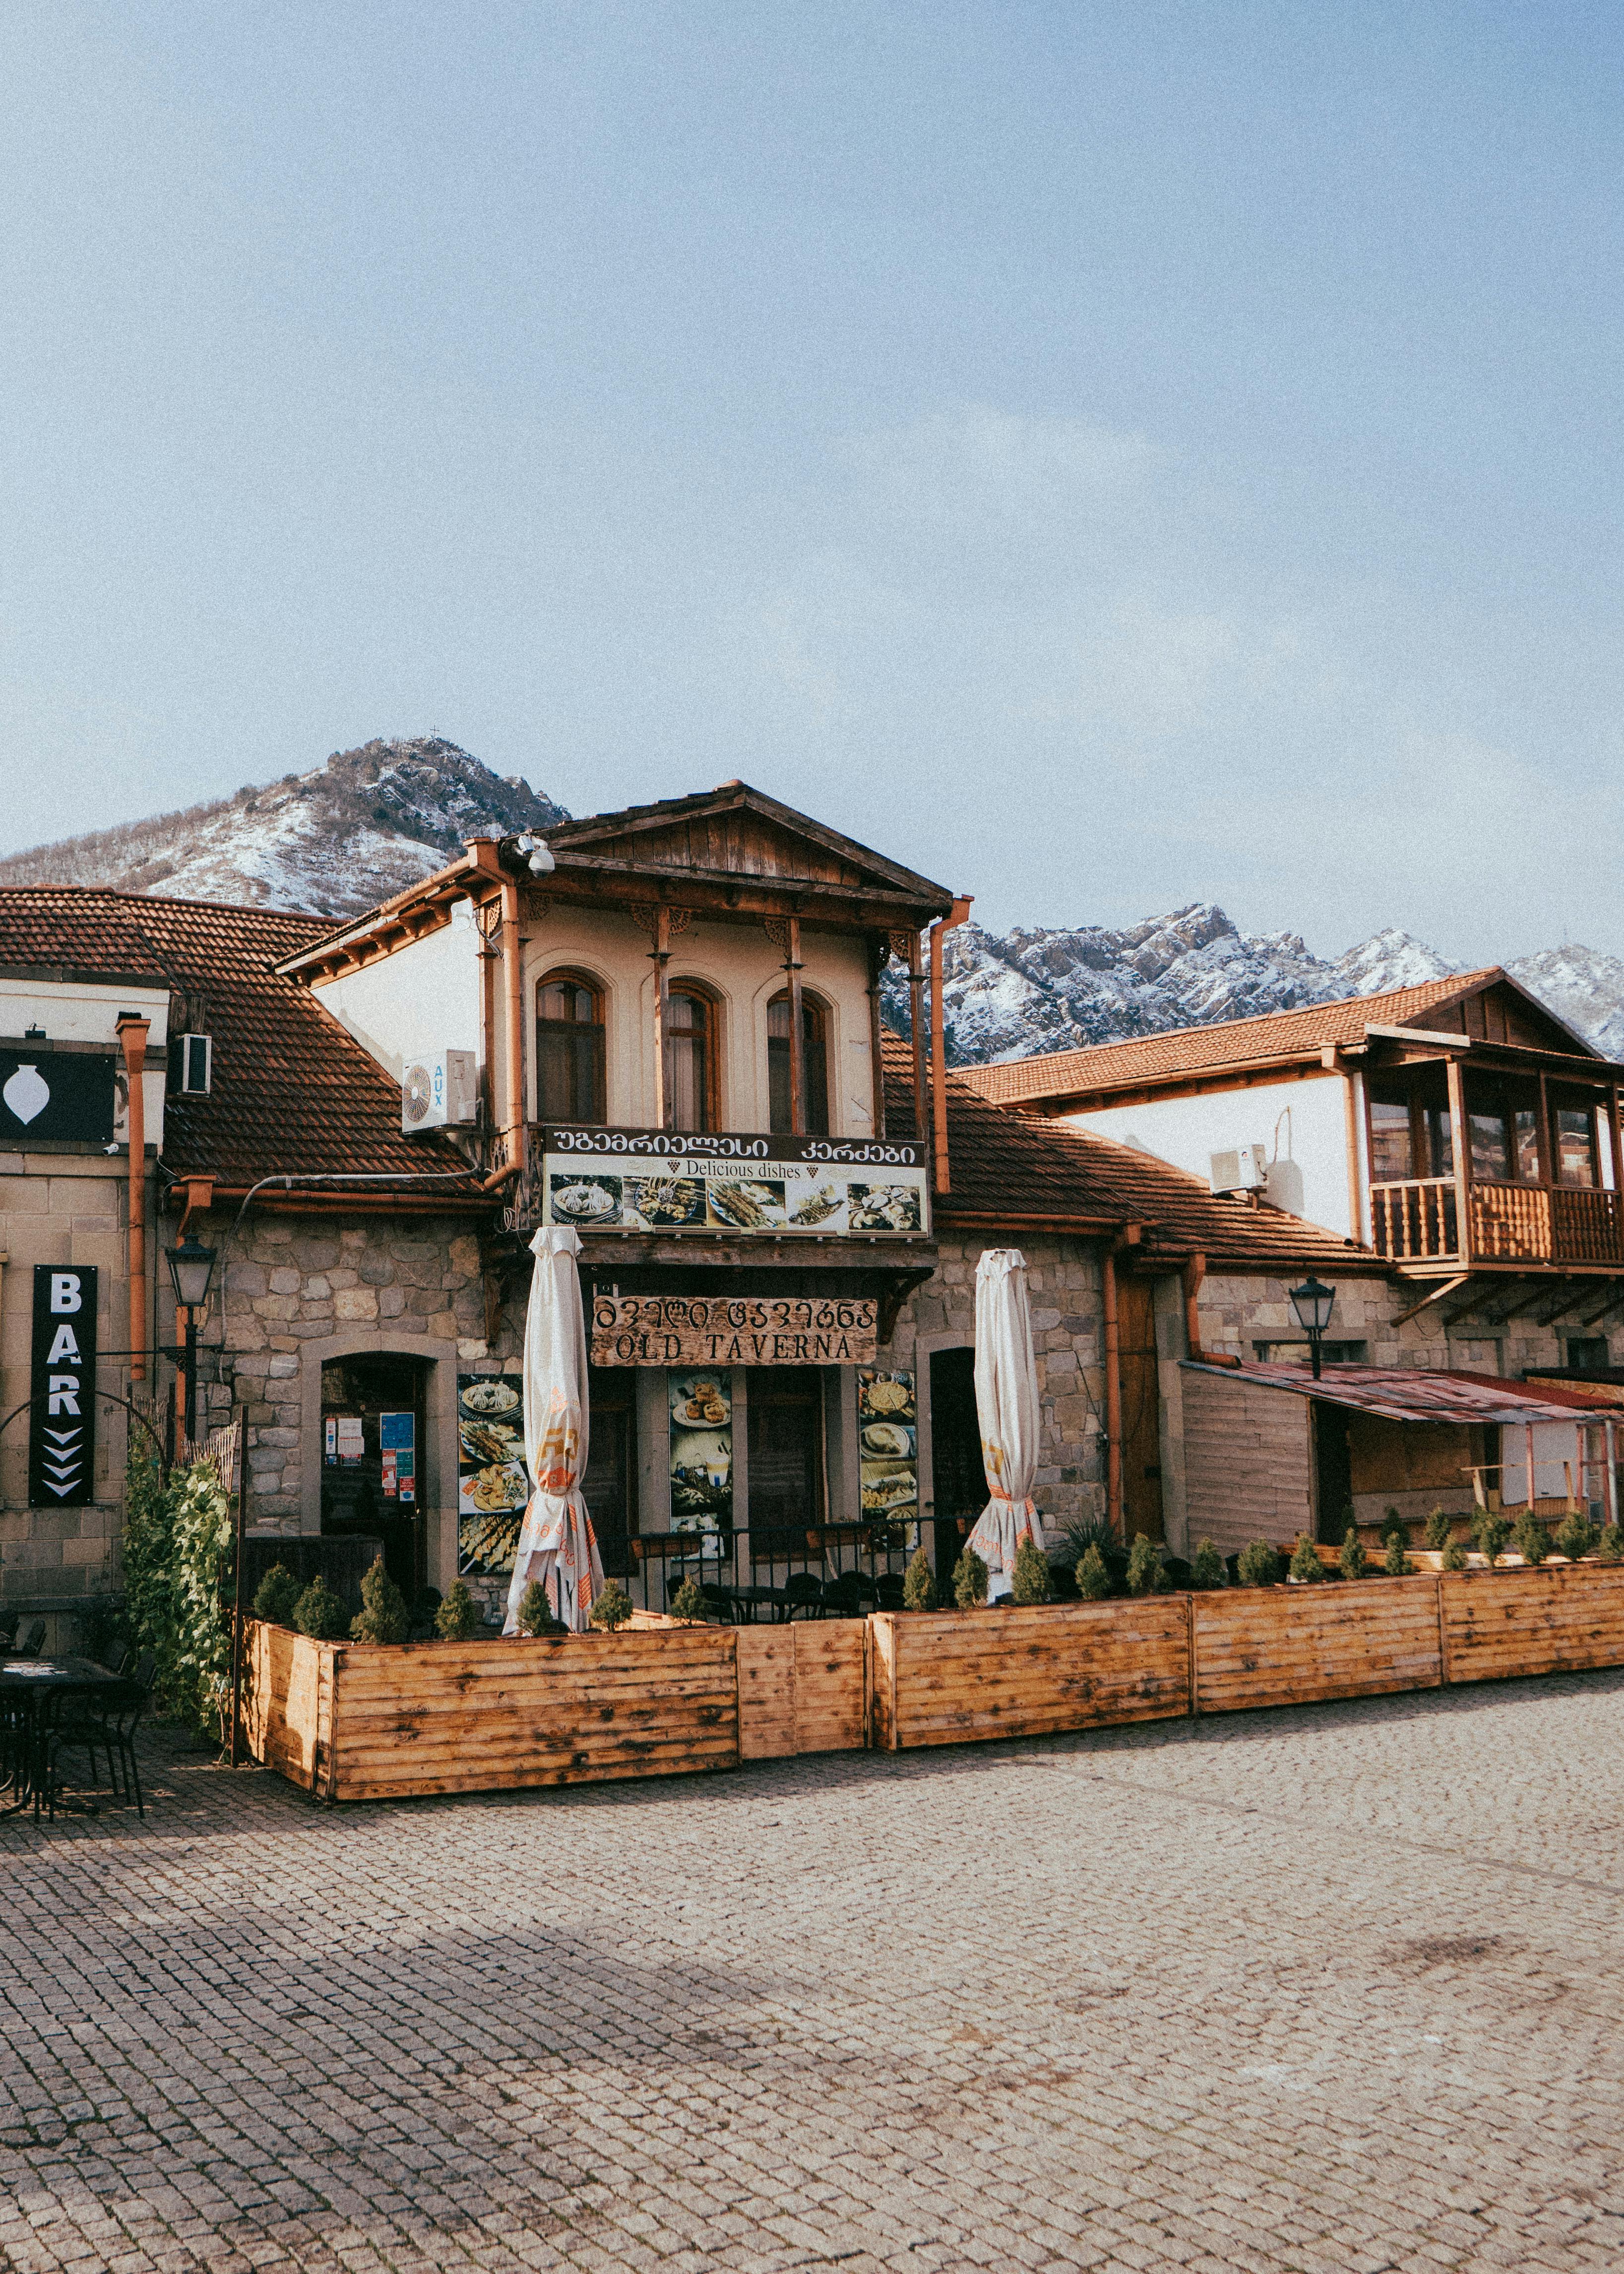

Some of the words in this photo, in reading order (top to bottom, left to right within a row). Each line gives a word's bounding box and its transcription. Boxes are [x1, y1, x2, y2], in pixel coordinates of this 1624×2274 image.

[554, 1132, 768, 1157] უგემრიელესი
[802, 1142, 916, 1163] კერძები
[687, 1160, 753, 1176] Delicious
[759, 1163, 801, 1179] dishes
[597, 1300, 709, 1328] ძველი
[727, 1301, 874, 1328] ტავერნა
[46, 1273, 82, 1415] BAR
[617, 1334, 681, 1359] OLD
[705, 1334, 851, 1359] TAVERNA
